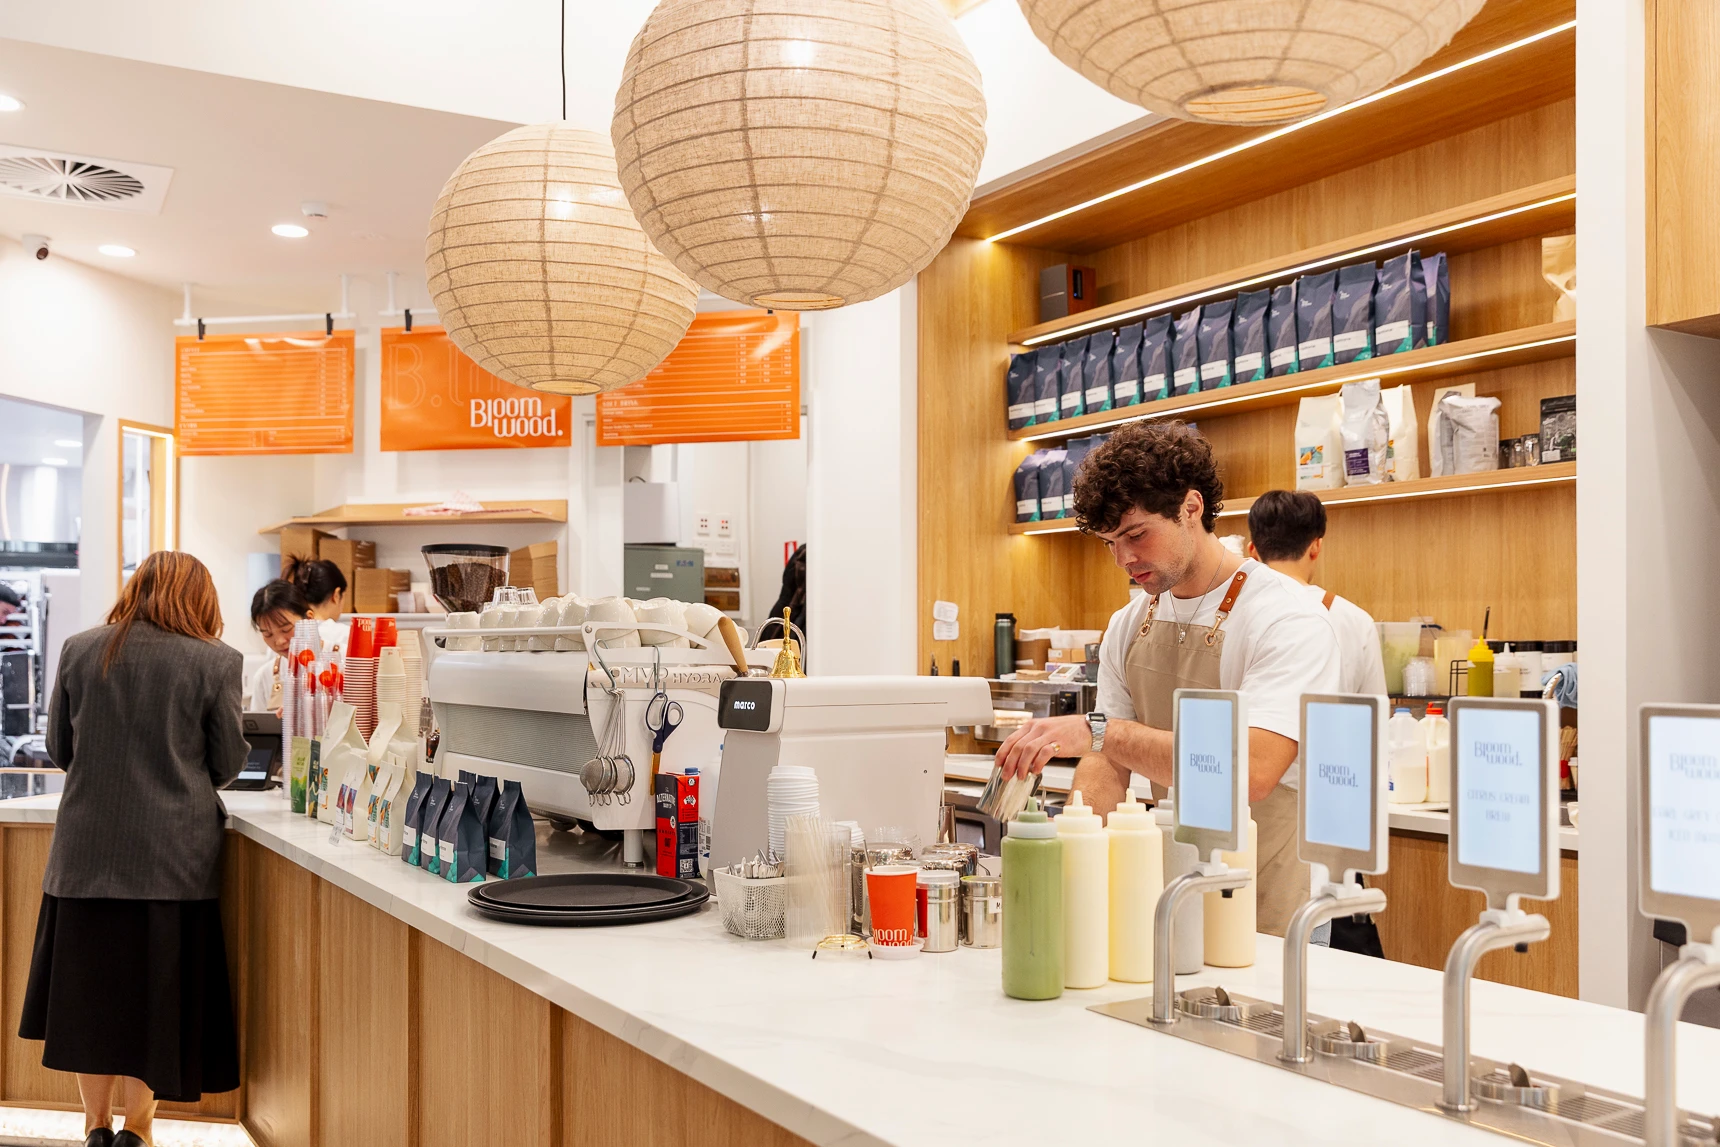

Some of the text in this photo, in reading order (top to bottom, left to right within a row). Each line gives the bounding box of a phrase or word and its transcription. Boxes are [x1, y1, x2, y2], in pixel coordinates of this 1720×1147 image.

[470, 396, 542, 428] Bloom
[493, 408, 564, 437] wood.
[619, 666, 722, 684] MVP HYDRA
[733, 700, 756, 710] marco
[1474, 740, 1512, 757] Bloom
[1189, 753, 1216, 767] Bloom
[1197, 761, 1223, 775] wood.
[1318, 763, 1351, 778] Bloom
[1328, 773, 1359, 788] wood.
